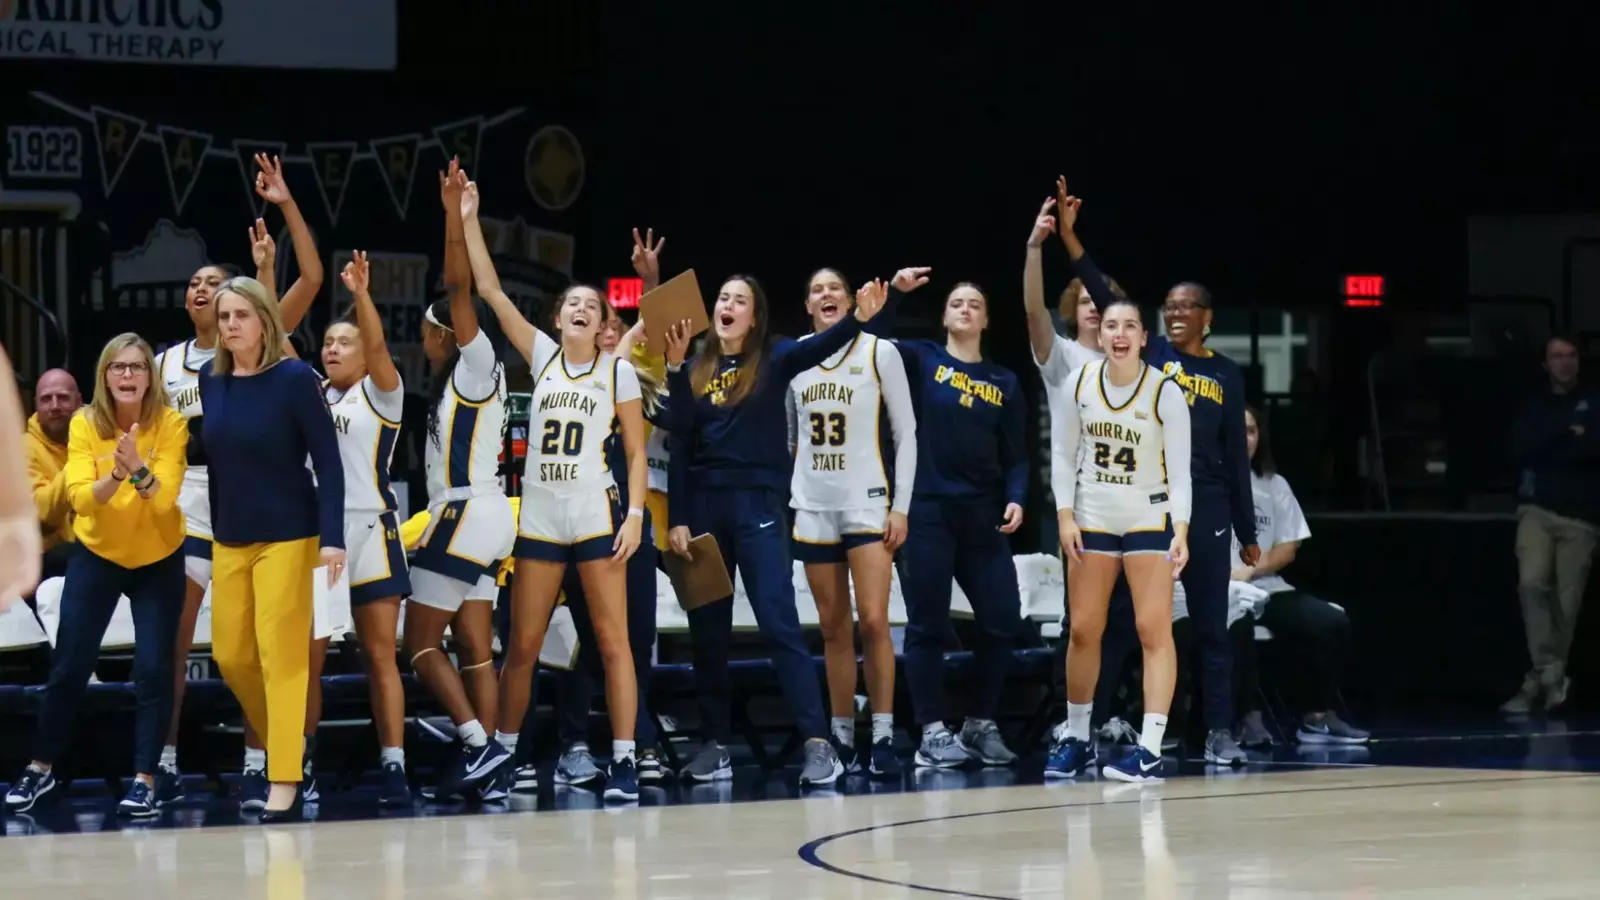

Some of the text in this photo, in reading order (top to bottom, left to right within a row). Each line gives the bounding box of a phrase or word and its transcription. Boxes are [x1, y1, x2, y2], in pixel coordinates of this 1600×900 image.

[0, 29, 224, 61] ICAL THERAPY
[11, 129, 82, 174] 1922
[608, 278, 645, 307] EXIT
[539, 391, 597, 417] MURRAY
[801, 382, 853, 407] MURRAY
[541, 419, 584, 456] 20
[810, 411, 846, 447] 33
[1086, 421, 1142, 445] MURRAY
[812, 453, 846, 471] STATE
[1093, 441, 1137, 473] 24
[540, 462, 578, 482] STATE
